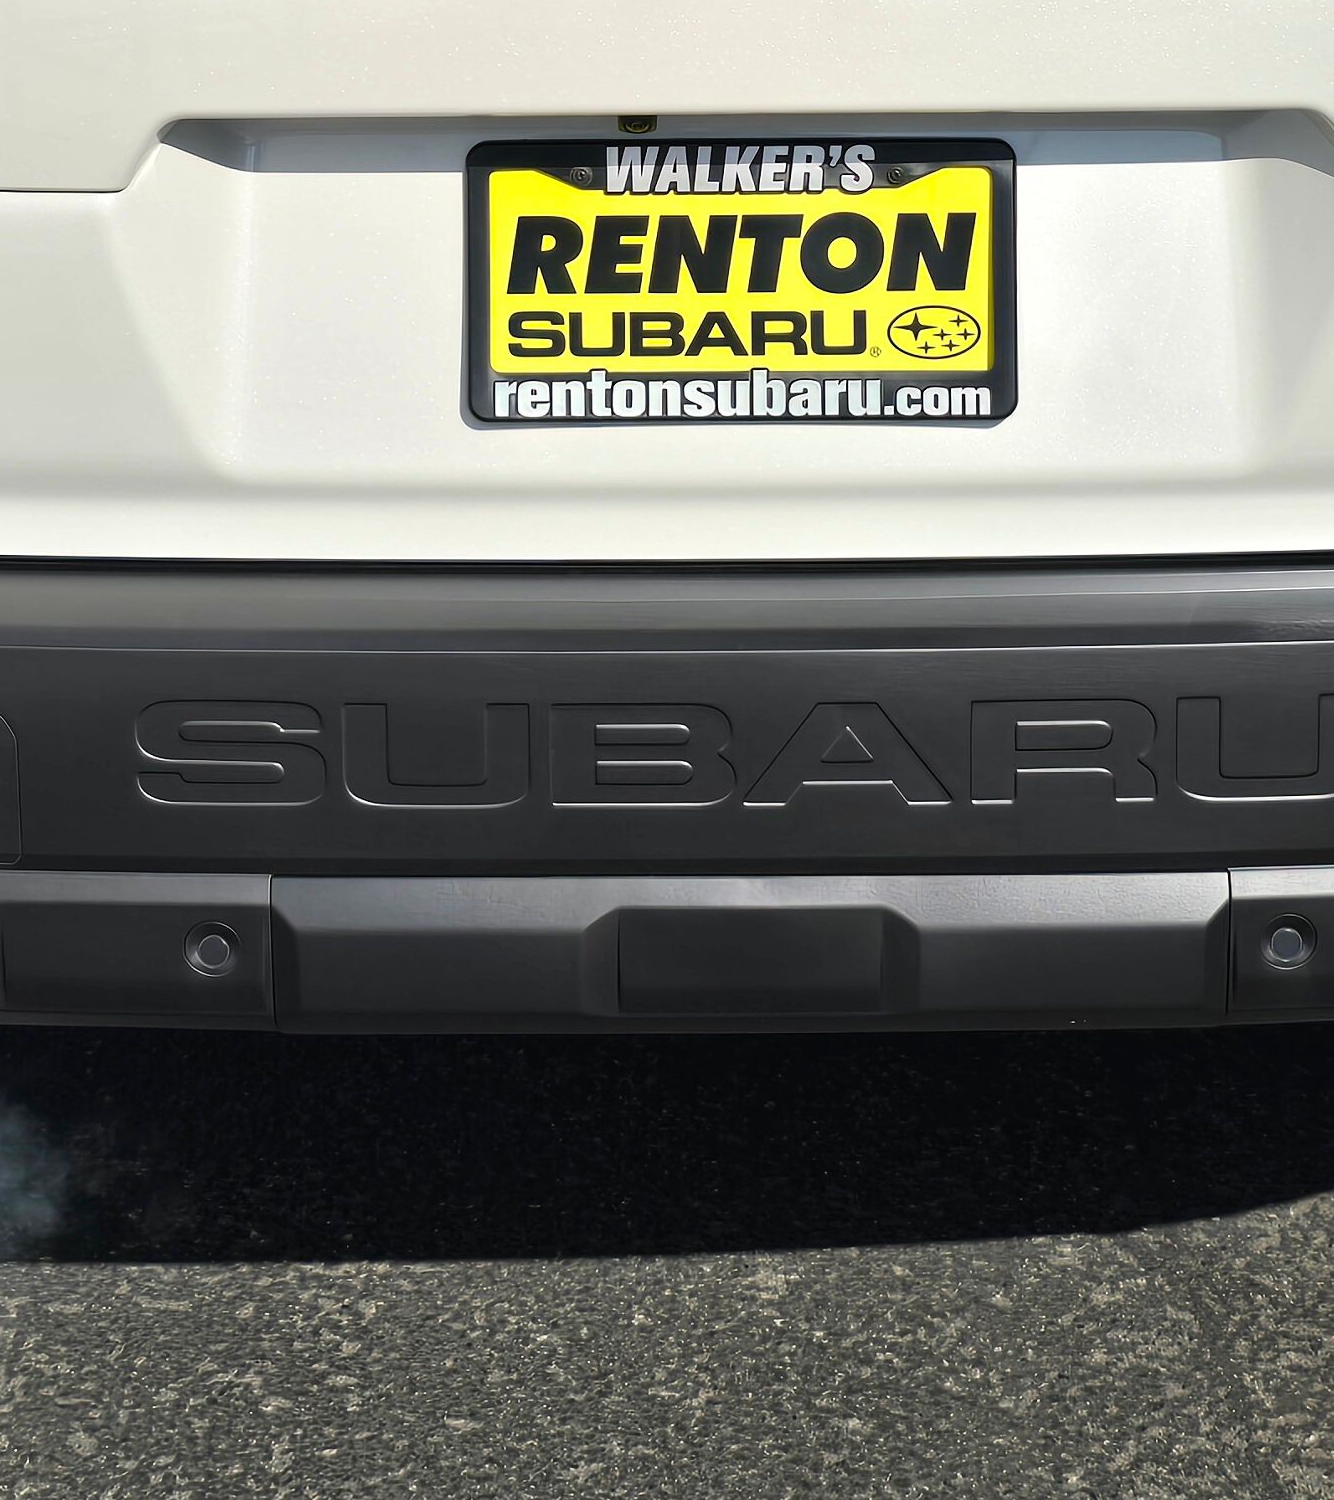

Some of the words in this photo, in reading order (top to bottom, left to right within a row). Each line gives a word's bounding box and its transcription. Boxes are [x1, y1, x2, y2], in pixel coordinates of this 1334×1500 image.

[603, 144, 876, 195] WALKER'S
[506, 211, 977, 295] RENTON
[507, 309, 868, 358] SUBARU
[492, 367, 992, 419] rentonsubaru.com
